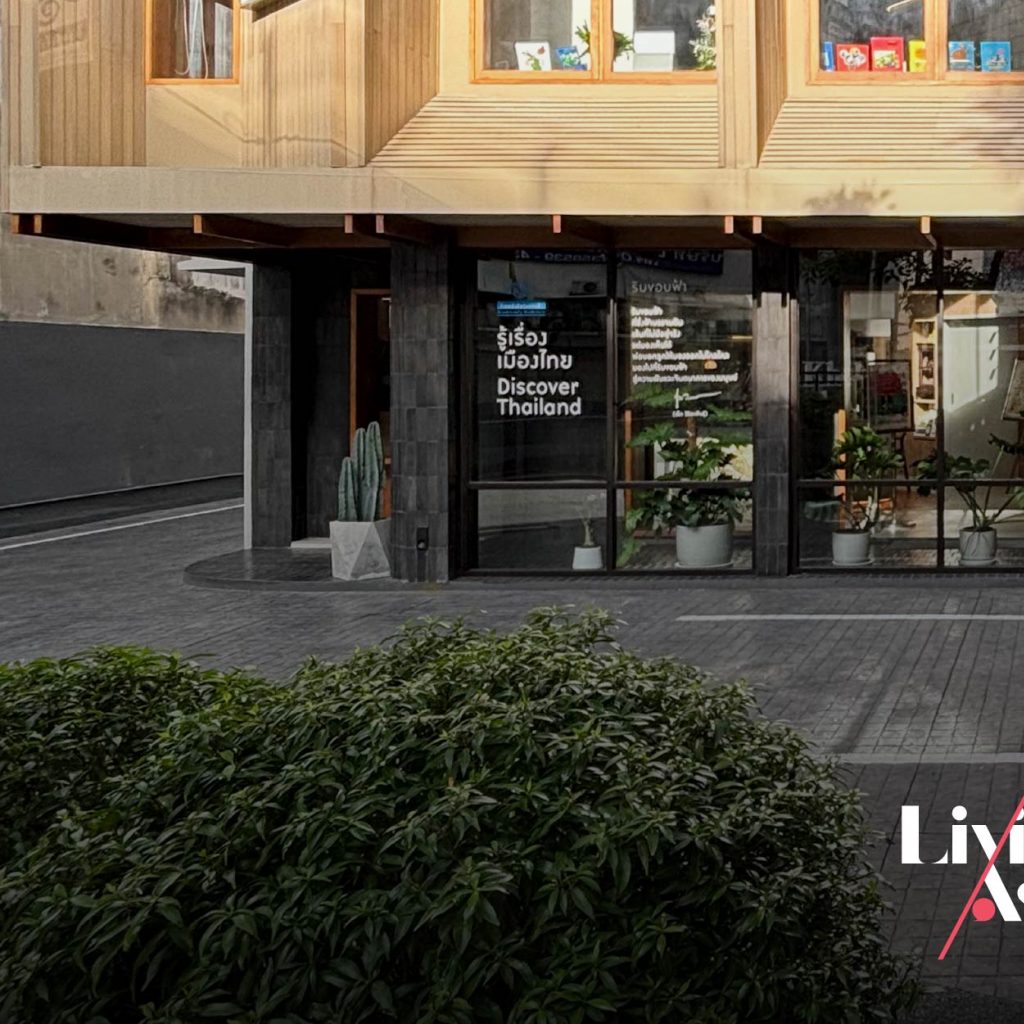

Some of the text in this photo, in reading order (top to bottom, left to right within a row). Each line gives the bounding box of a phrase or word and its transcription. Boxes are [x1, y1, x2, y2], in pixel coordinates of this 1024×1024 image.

[496, 322, 548, 352] รู้เรื่อง
[496, 347, 573, 370] เมืองไทย
[496, 377, 580, 396] Discover
[496, 396, 583, 417] Thailand
